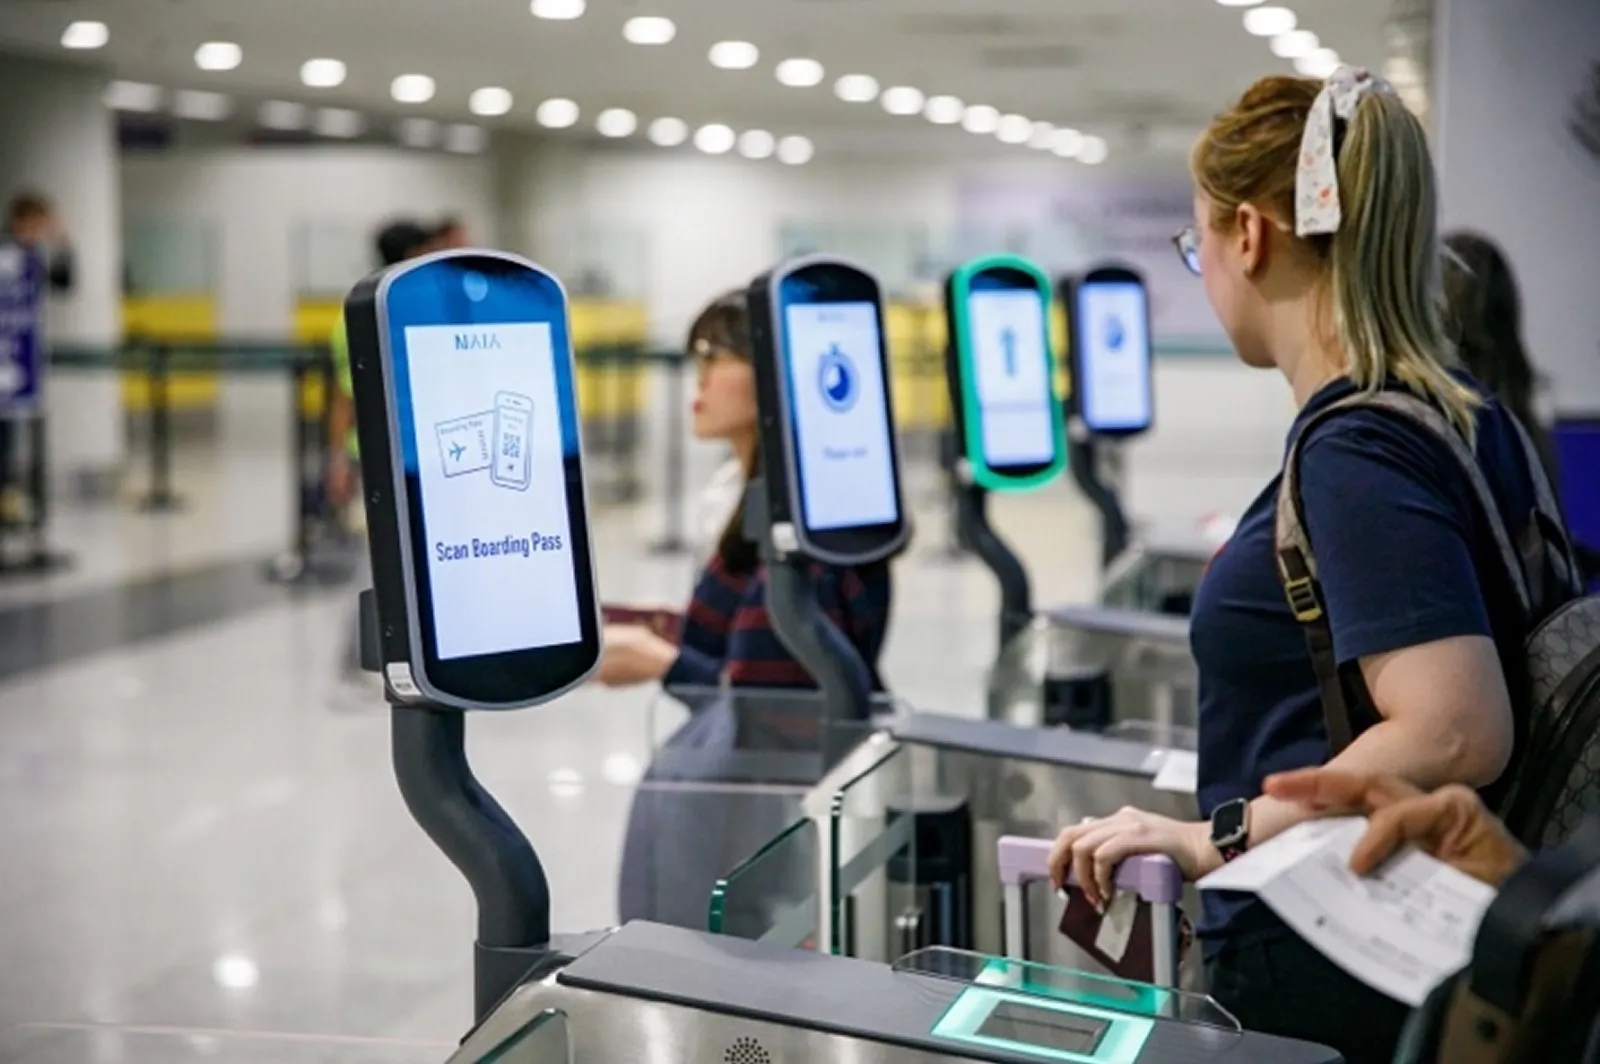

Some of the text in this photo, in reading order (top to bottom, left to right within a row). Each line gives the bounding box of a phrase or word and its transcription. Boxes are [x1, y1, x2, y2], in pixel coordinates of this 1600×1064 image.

[455, 332, 501, 350] NAIA
[436, 531, 562, 561] Scan Boarding Pass
